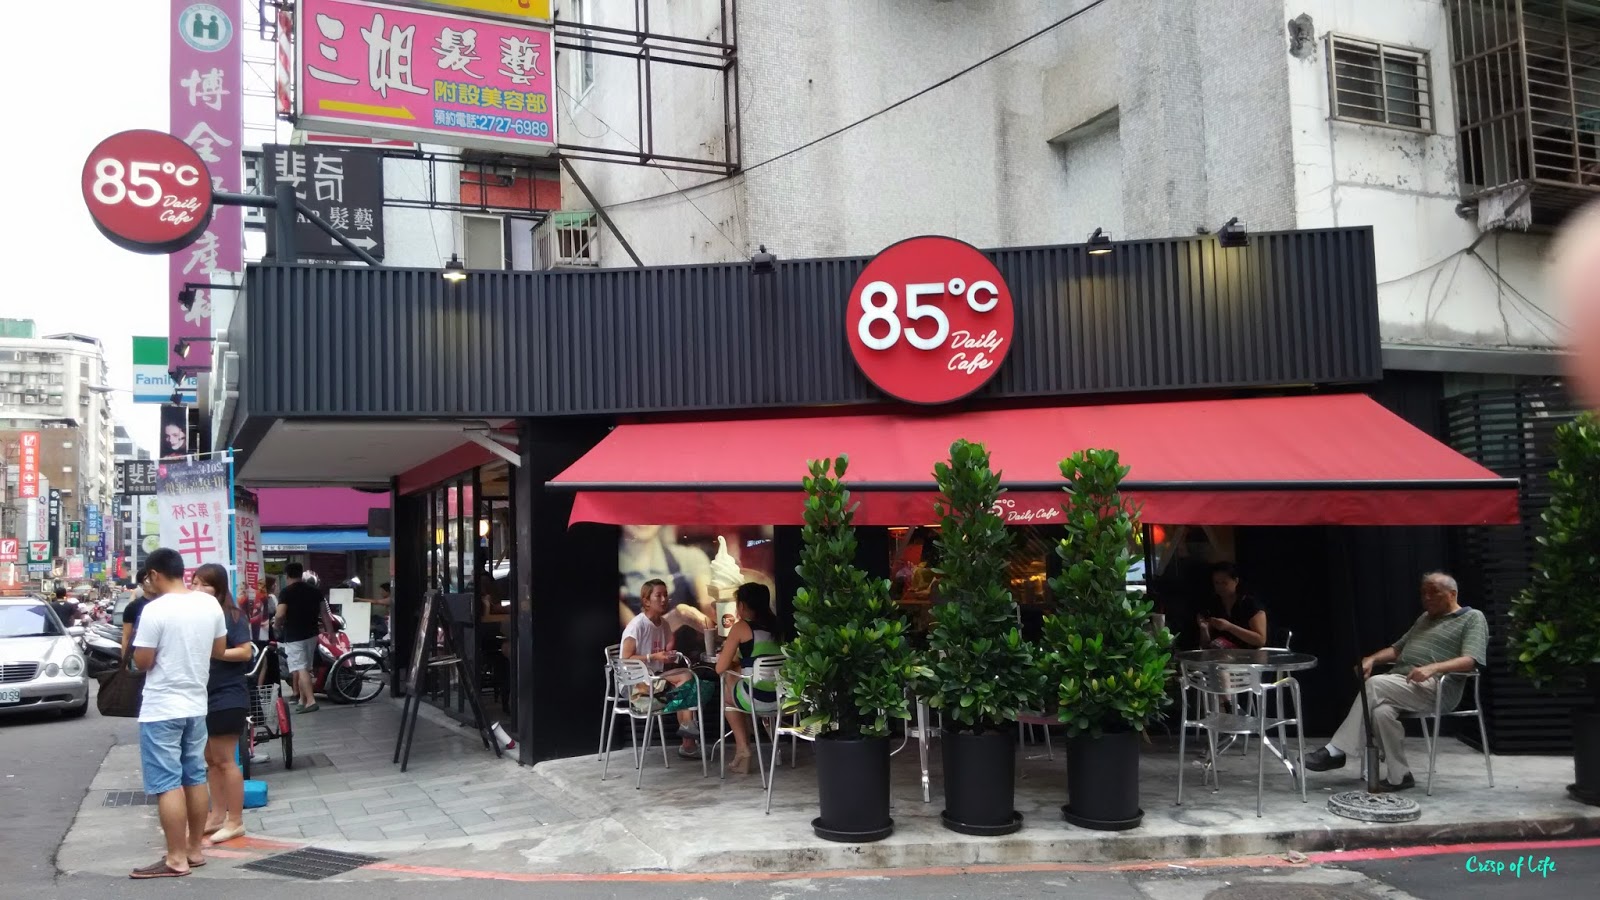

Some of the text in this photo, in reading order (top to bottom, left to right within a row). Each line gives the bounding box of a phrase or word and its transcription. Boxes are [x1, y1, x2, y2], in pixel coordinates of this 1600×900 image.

[434, 80, 548, 113] 附設美容部
[434, 109, 549, 137] 預約電話:2727-6989
[93, 158, 199, 207] 85°C
[275, 150, 344, 202] 斐奇
[163, 195, 201, 212] Daily
[160, 209, 193, 225] Cafe
[330, 207, 373, 231] 髮藝
[858, 278, 999, 350] 85°C
[951, 330, 1003, 353] Daily
[948, 352, 993, 375] Cafe
[980, 499, 1059, 521] 5°C Daily Cafe
